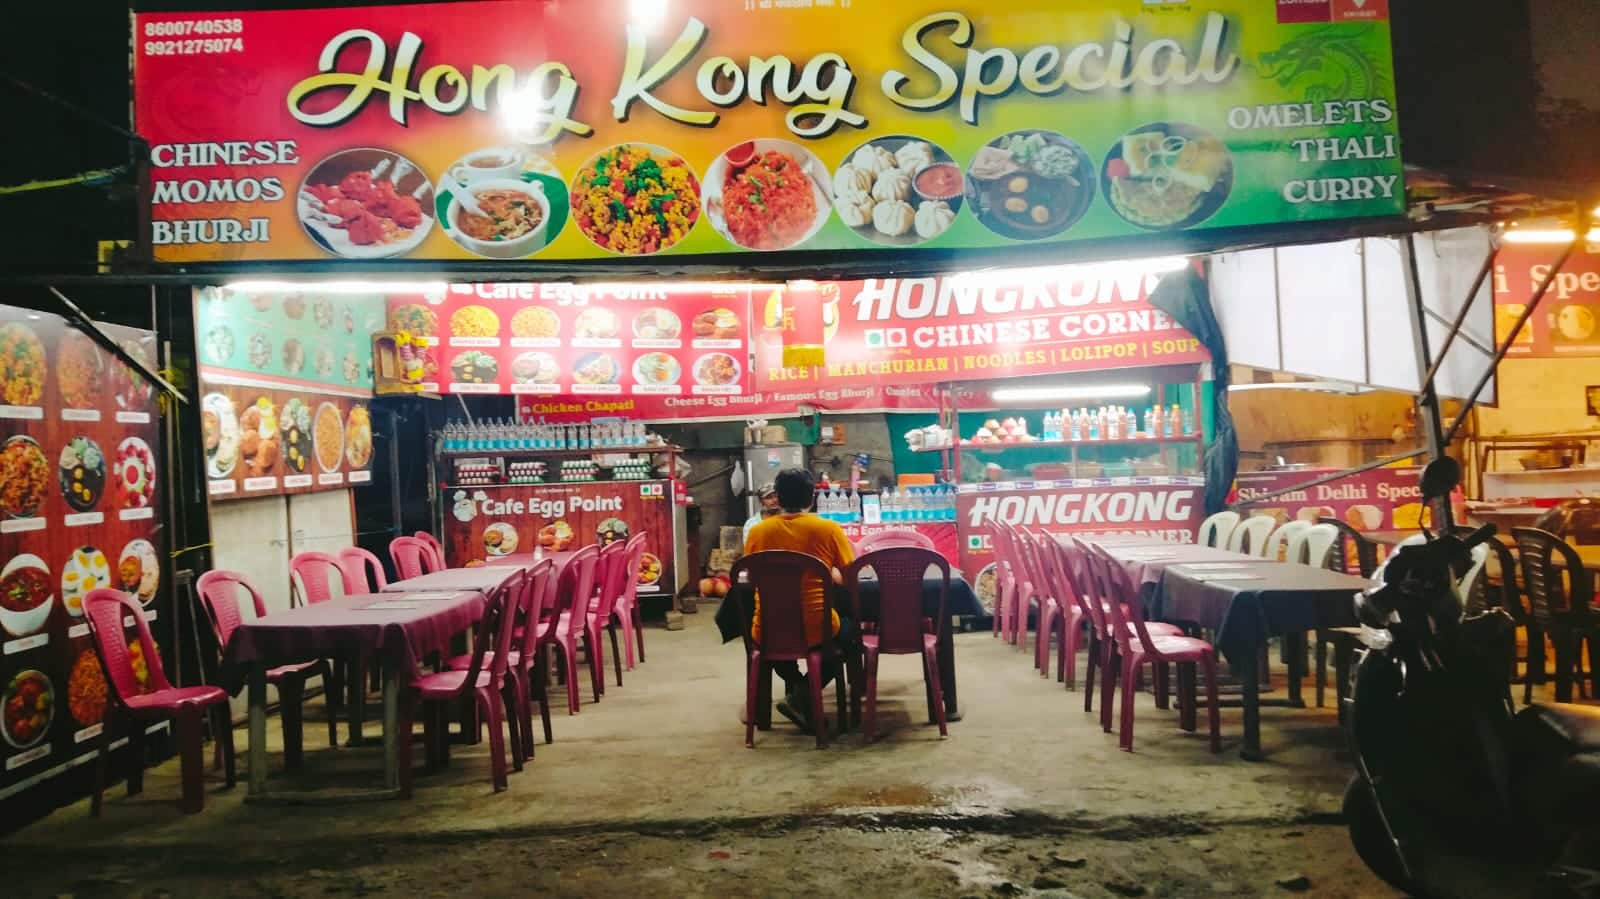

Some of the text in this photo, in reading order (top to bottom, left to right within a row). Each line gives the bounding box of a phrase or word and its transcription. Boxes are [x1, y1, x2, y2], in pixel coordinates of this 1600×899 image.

[145, 18, 243, 36] 8600740538
[145, 38, 243, 56] 9921275074
[287, 11, 1239, 143] Hong Kong Special
[1228, 100, 1392, 129] OMELETS
[151, 140, 299, 168] CHINESE
[1292, 135, 1396, 162] THALI
[152, 177, 285, 204] MOMOS
[1283, 175, 1398, 203] CURRY
[152, 218, 270, 244] BHURJI
[913, 309, 1184, 349] CHINESE CORNE
[768, 338, 1199, 381] RICE MANCHURIAN NOODLES LOLIPOP SOUP
[532, 400, 634, 413] Chicken Chapati
[1317, 484, 1368, 500] Delhi
[481, 496, 622, 518] Cafe Egg Point
[968, 490, 1193, 527] HONGKONG
